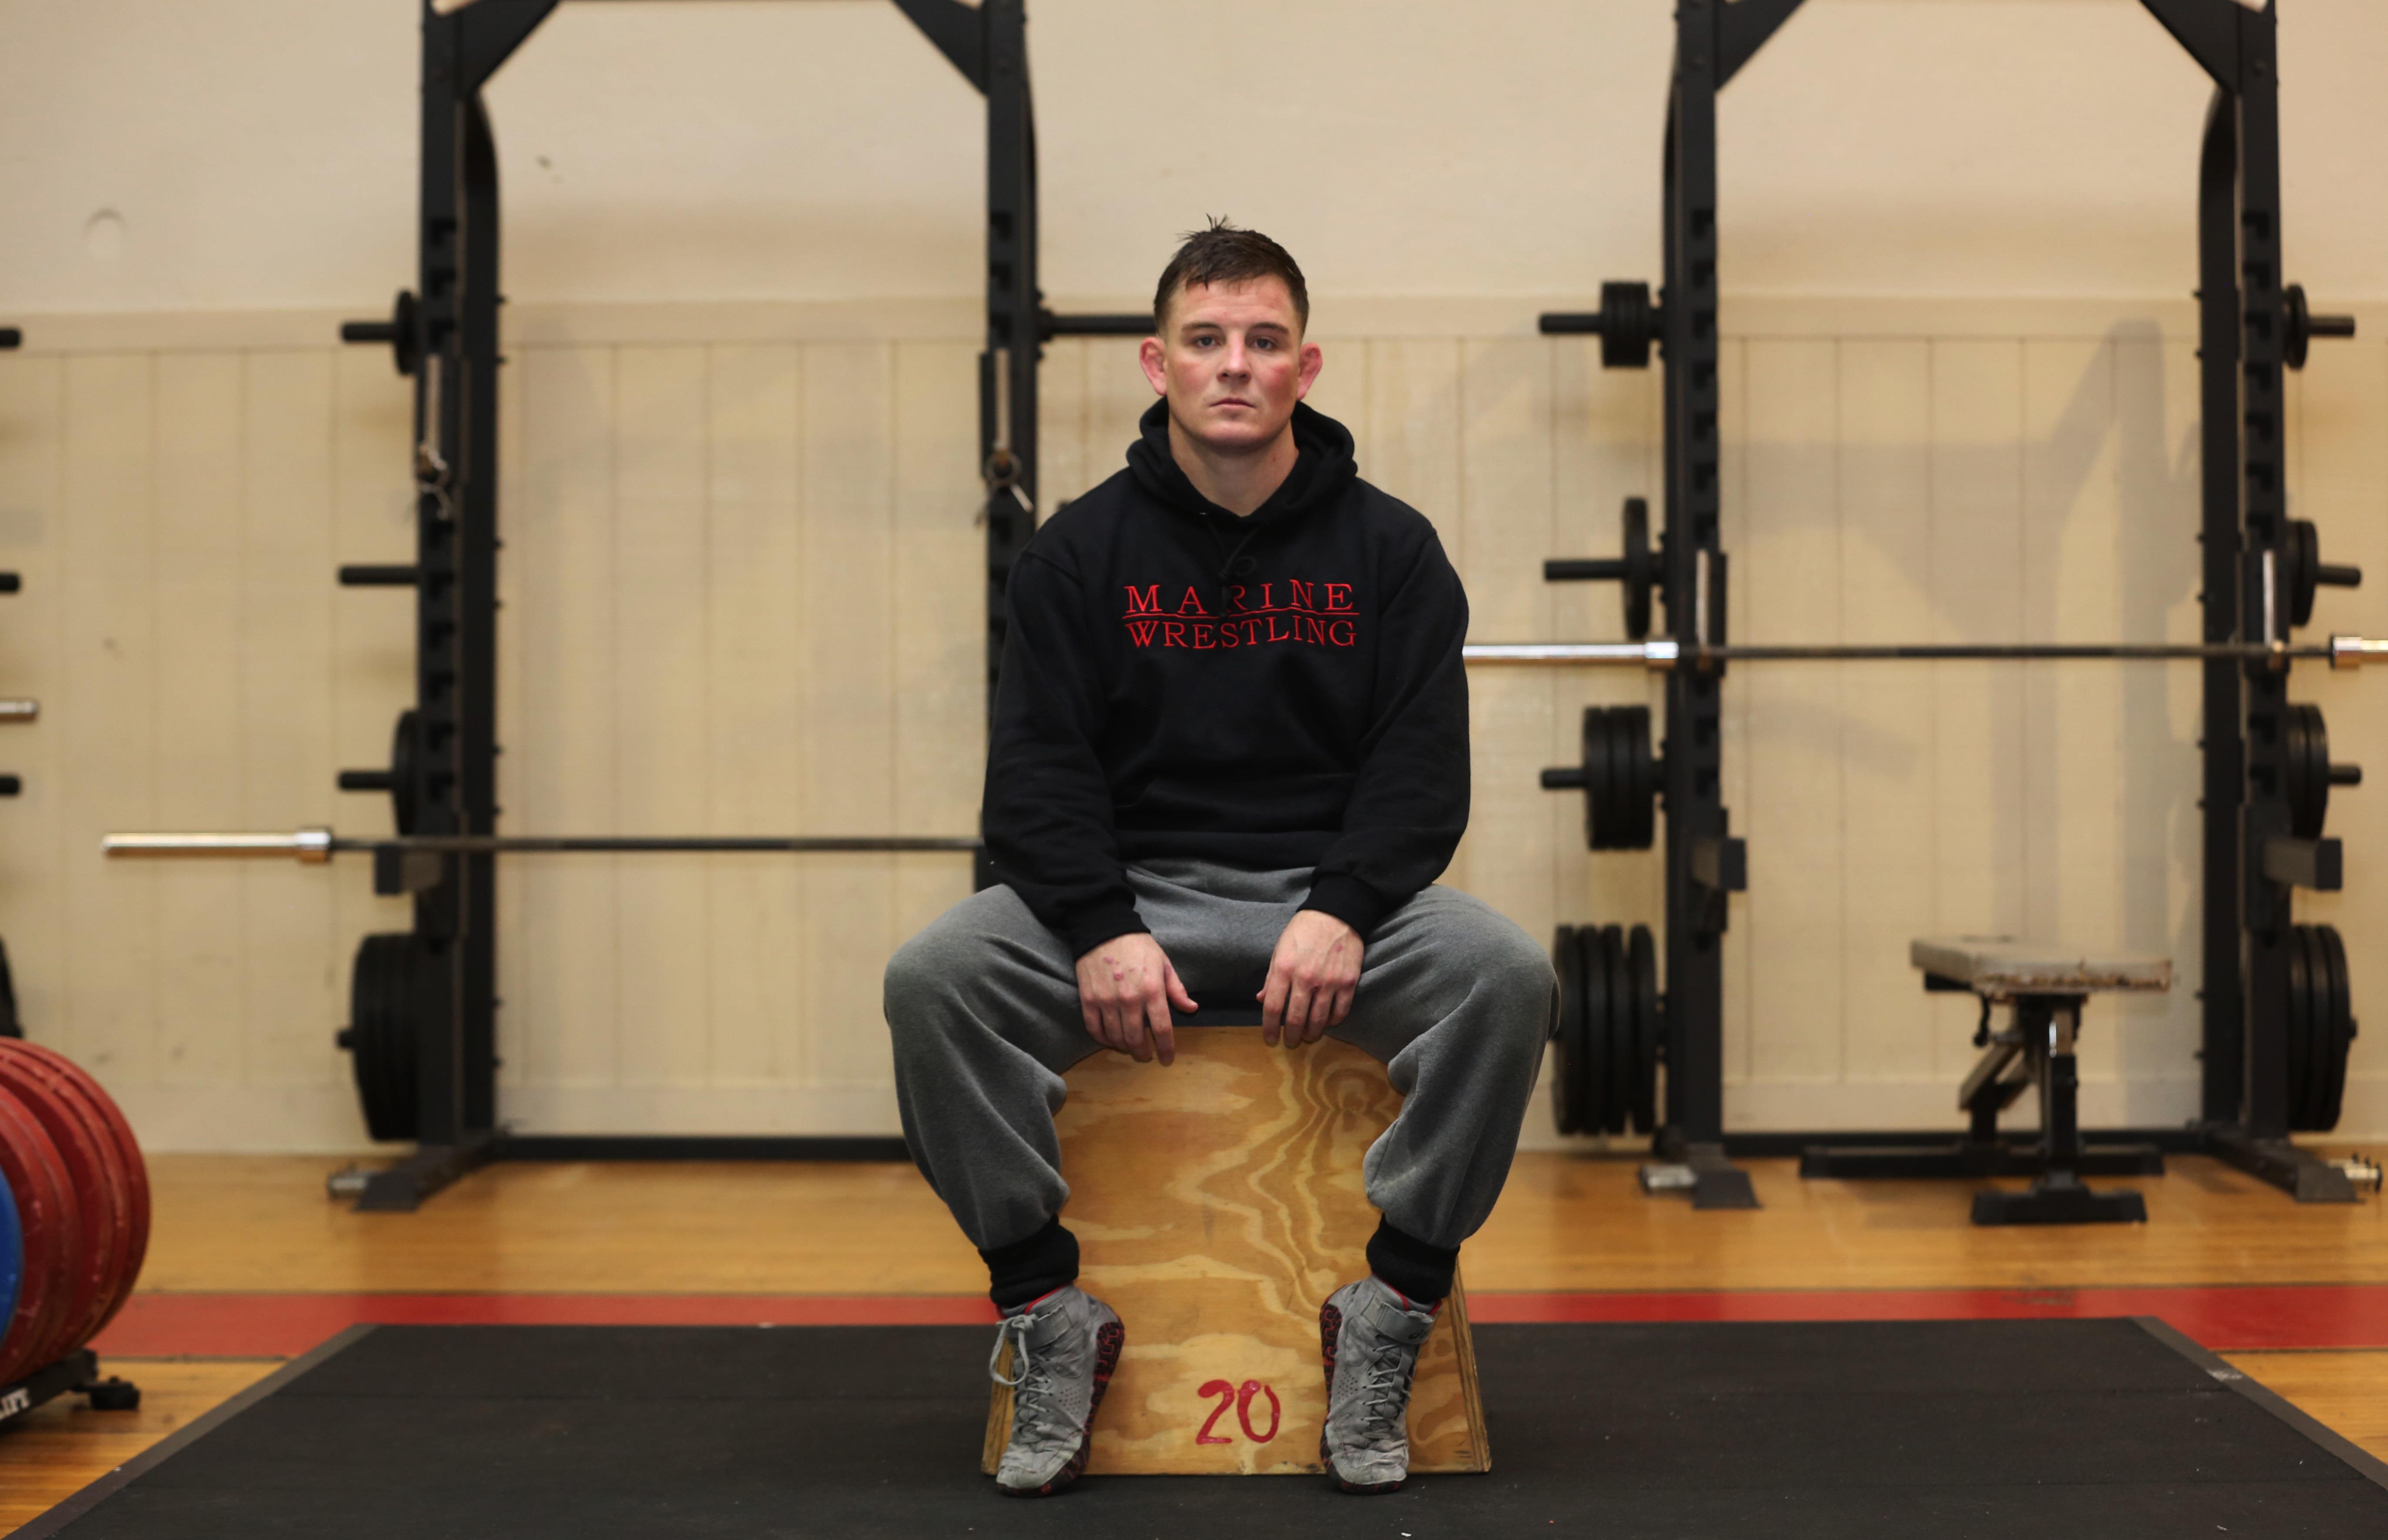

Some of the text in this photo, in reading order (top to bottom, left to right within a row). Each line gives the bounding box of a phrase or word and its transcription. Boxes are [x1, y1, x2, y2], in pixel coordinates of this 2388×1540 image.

[1124, 579, 1353, 614] MARINE
[1125, 616, 1357, 649] WRESTLING
[1196, 1379, 1281, 1445] 20
